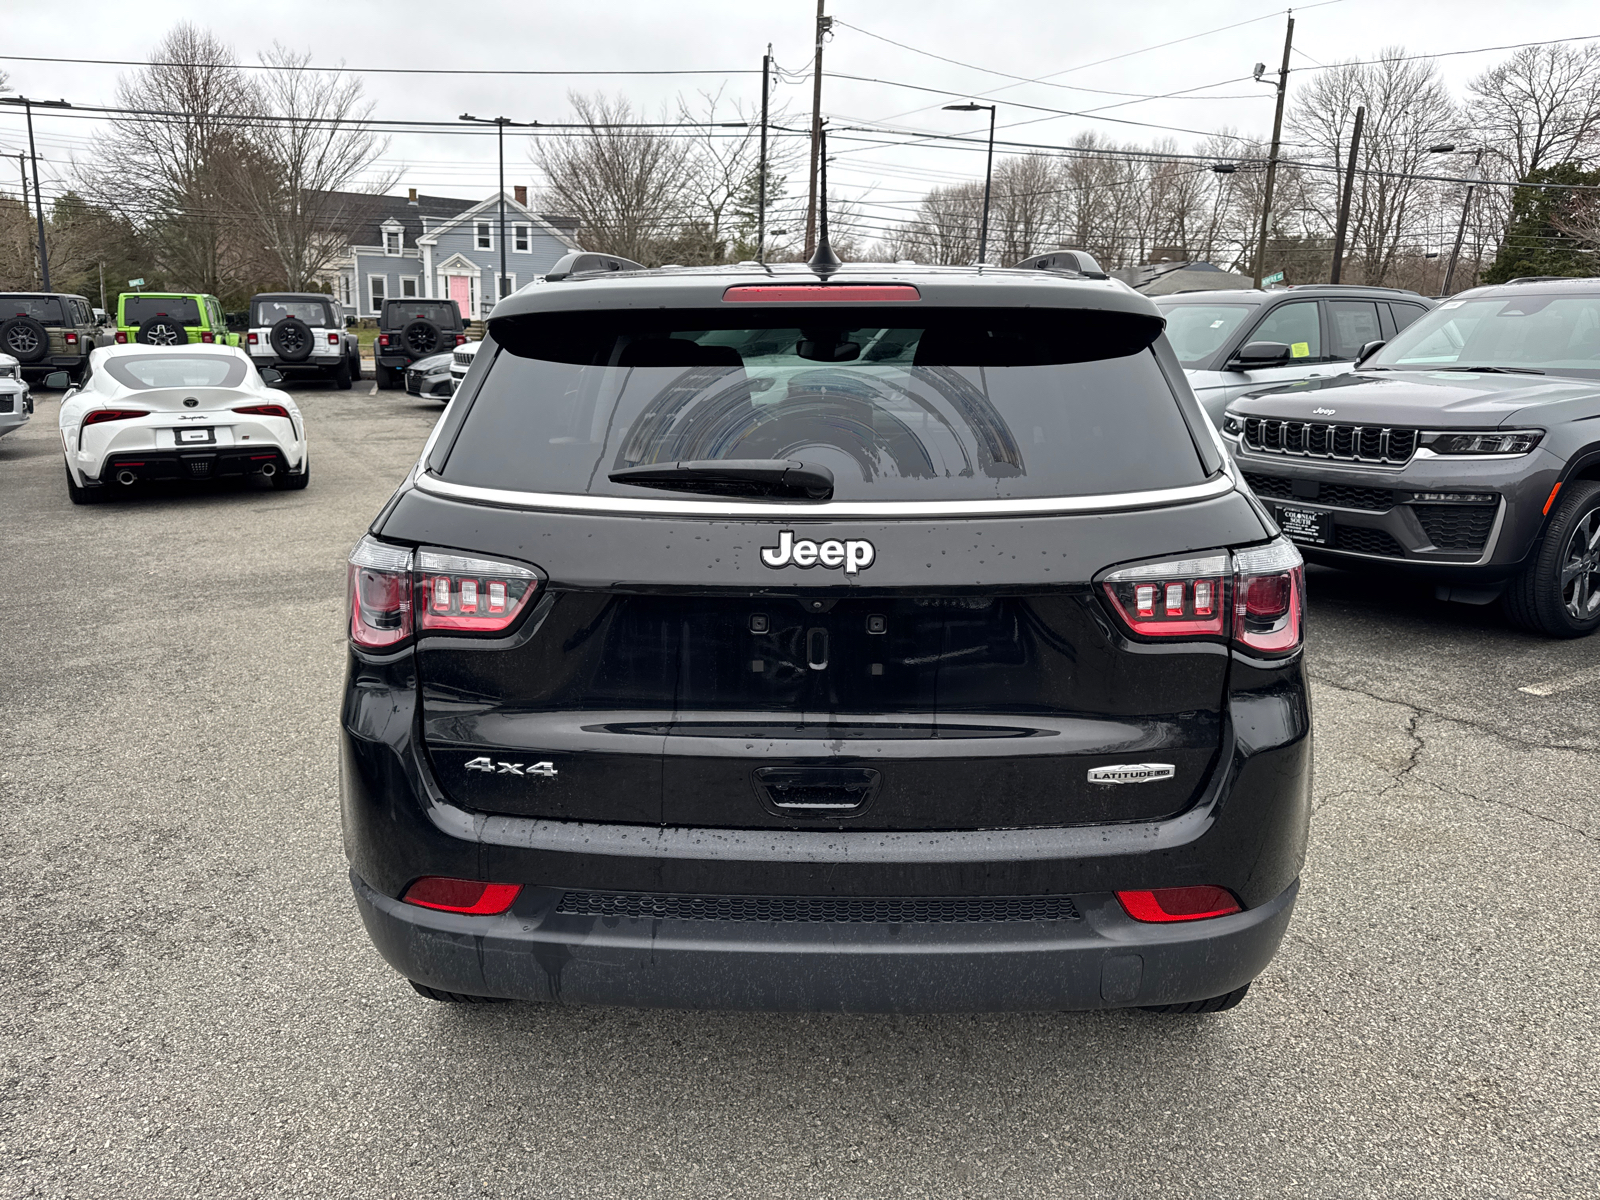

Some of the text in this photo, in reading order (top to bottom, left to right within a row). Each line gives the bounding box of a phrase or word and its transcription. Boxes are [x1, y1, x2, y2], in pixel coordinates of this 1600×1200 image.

[1312, 407, 1336, 416] Jeep
[1284, 511, 1317, 521] COLONIAL
[1290, 518, 1311, 526] SOUTH
[761, 531, 875, 574] Jeep
[1093, 770, 1154, 780] LATITUDE
